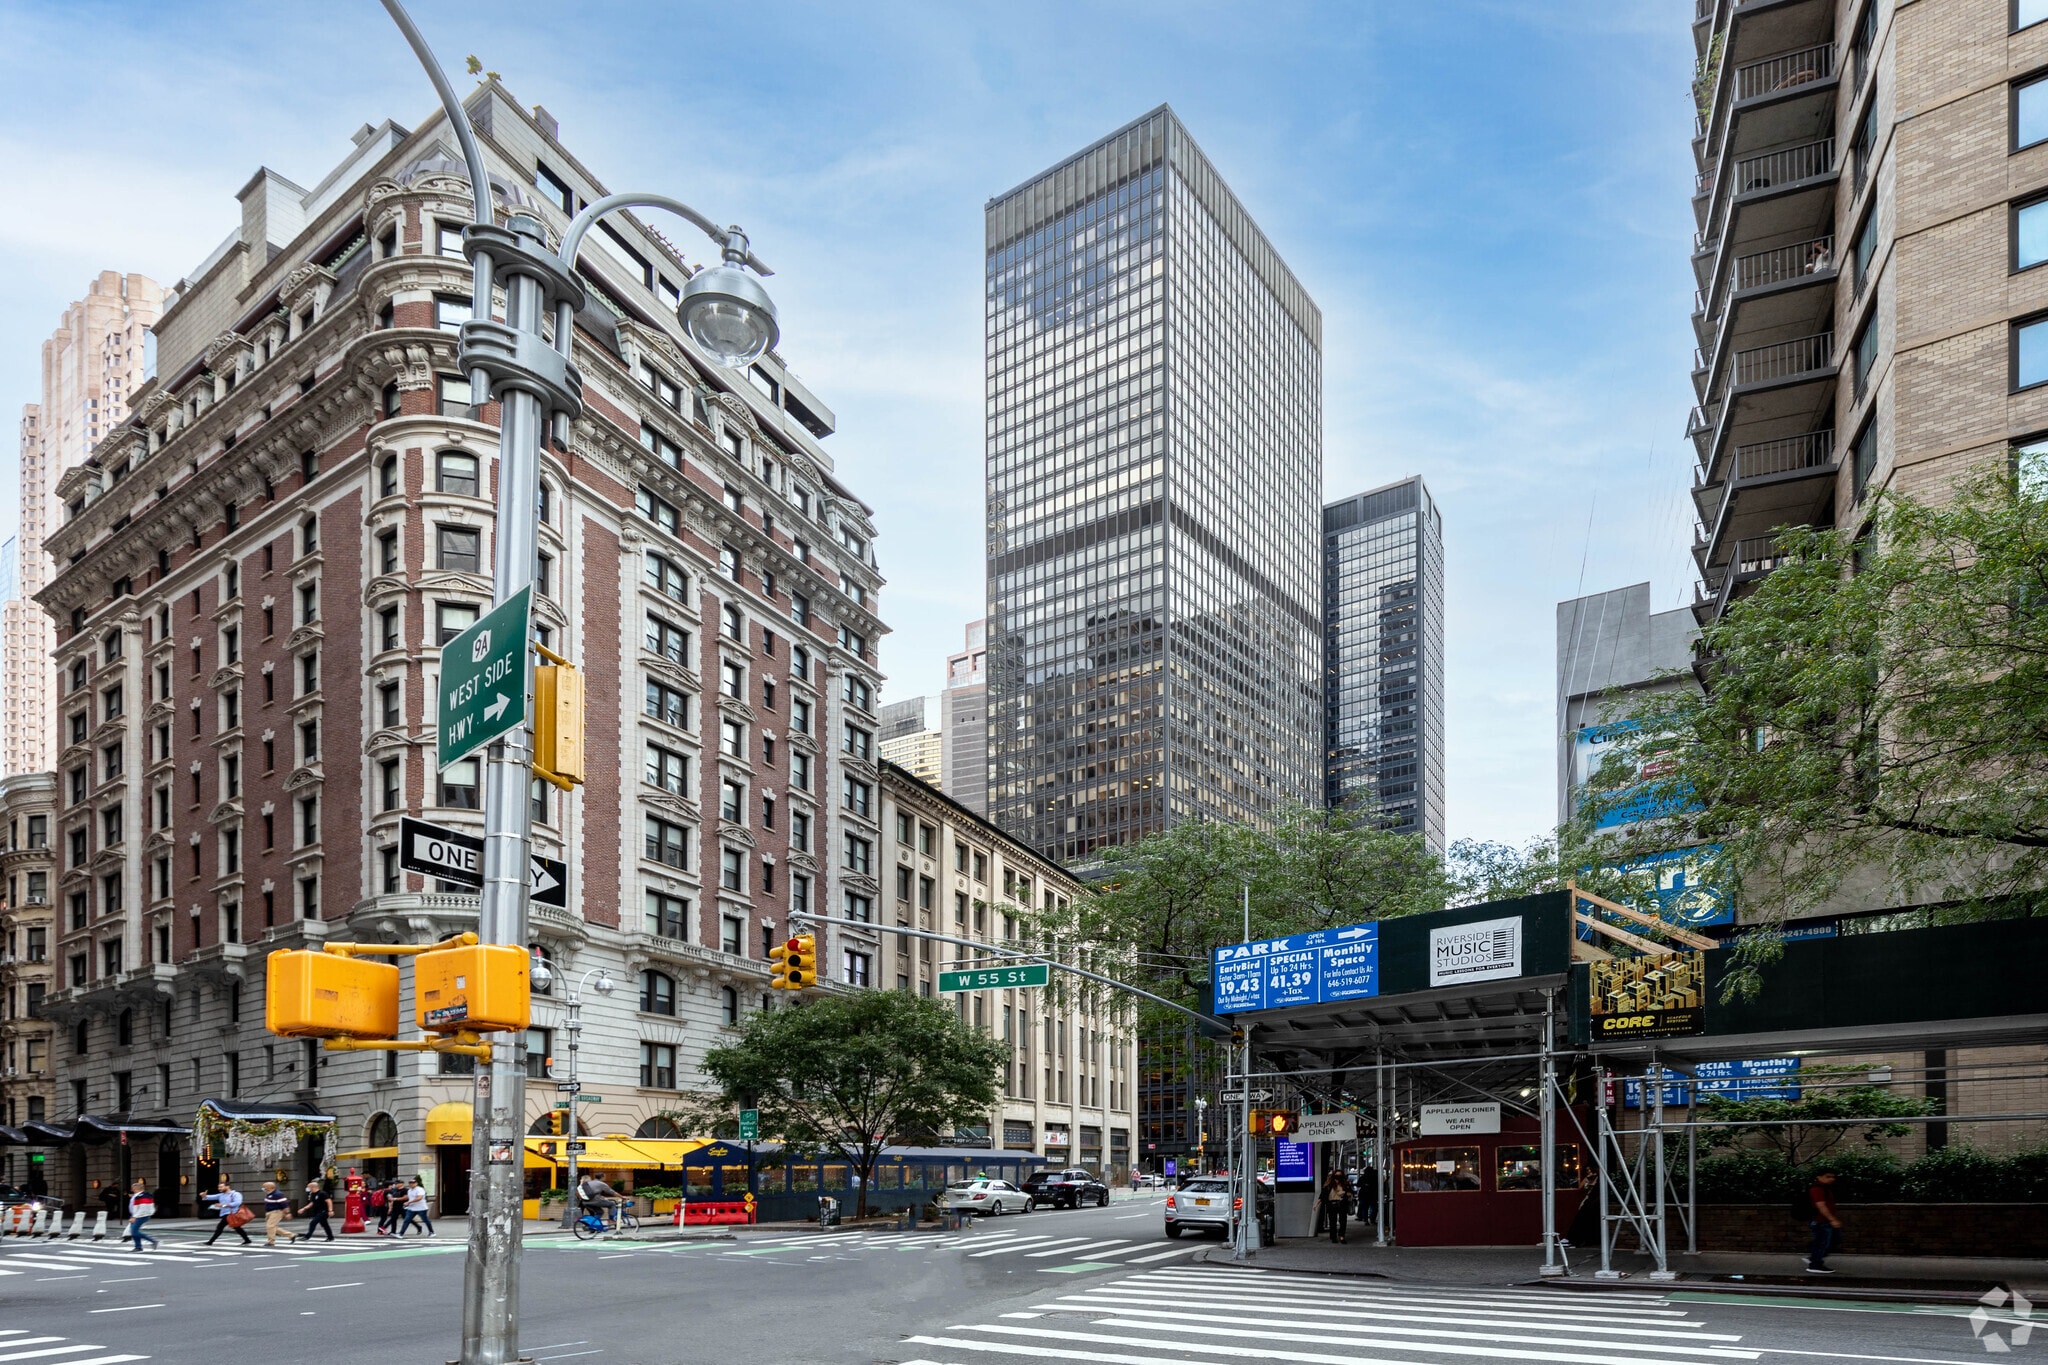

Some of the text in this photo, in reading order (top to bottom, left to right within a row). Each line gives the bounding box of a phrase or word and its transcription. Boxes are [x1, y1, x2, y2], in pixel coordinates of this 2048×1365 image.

[474, 634, 488, 659] 9A
[449, 651, 513, 711] WEST SIDE
[449, 713, 474, 746] HWY
[428, 841, 478, 871] ONE
[1307, 932, 1325, 940] OPEN
[1437, 930, 1491, 946] RIVERSIDE
[1218, 939, 1290, 961] PARK
[1323, 943, 1373, 958] Monthly
[1437, 940, 1491, 958] MUSIC
[1270, 952, 1314, 966] SPECIAL
[1330, 955, 1366, 967] Space
[1437, 953, 1492, 968] STUDIOS
[1486, 962, 1512, 970] EVERYONE
[1270, 966, 1279, 975] Up
[1280, 965, 1288, 973] To
[1300, 962, 1314, 970] Hrs.
[1332, 969, 1341, 977] Info
[1341, 967, 1359, 975] Contact
[959, 971, 1026, 986] W 55 St
[1219, 974, 1232, 982] Enter
[1270, 971, 1311, 988] 41.39
[1327, 975, 1370, 988] 646-519-6077
[1220, 978, 1259, 995] 19.43
[1282, 987, 1303, 995] +Tax
[1603, 1015, 1655, 1030] CORE
[1742, 1058, 1794, 1068] Monthly
[1750, 1067, 1787, 1076] Space
[1249, 1091, 1267, 1099] WAY
[1298, 1119, 1345, 1129] APPLEJACK
[1308, 1128, 1336, 1136] DINER
